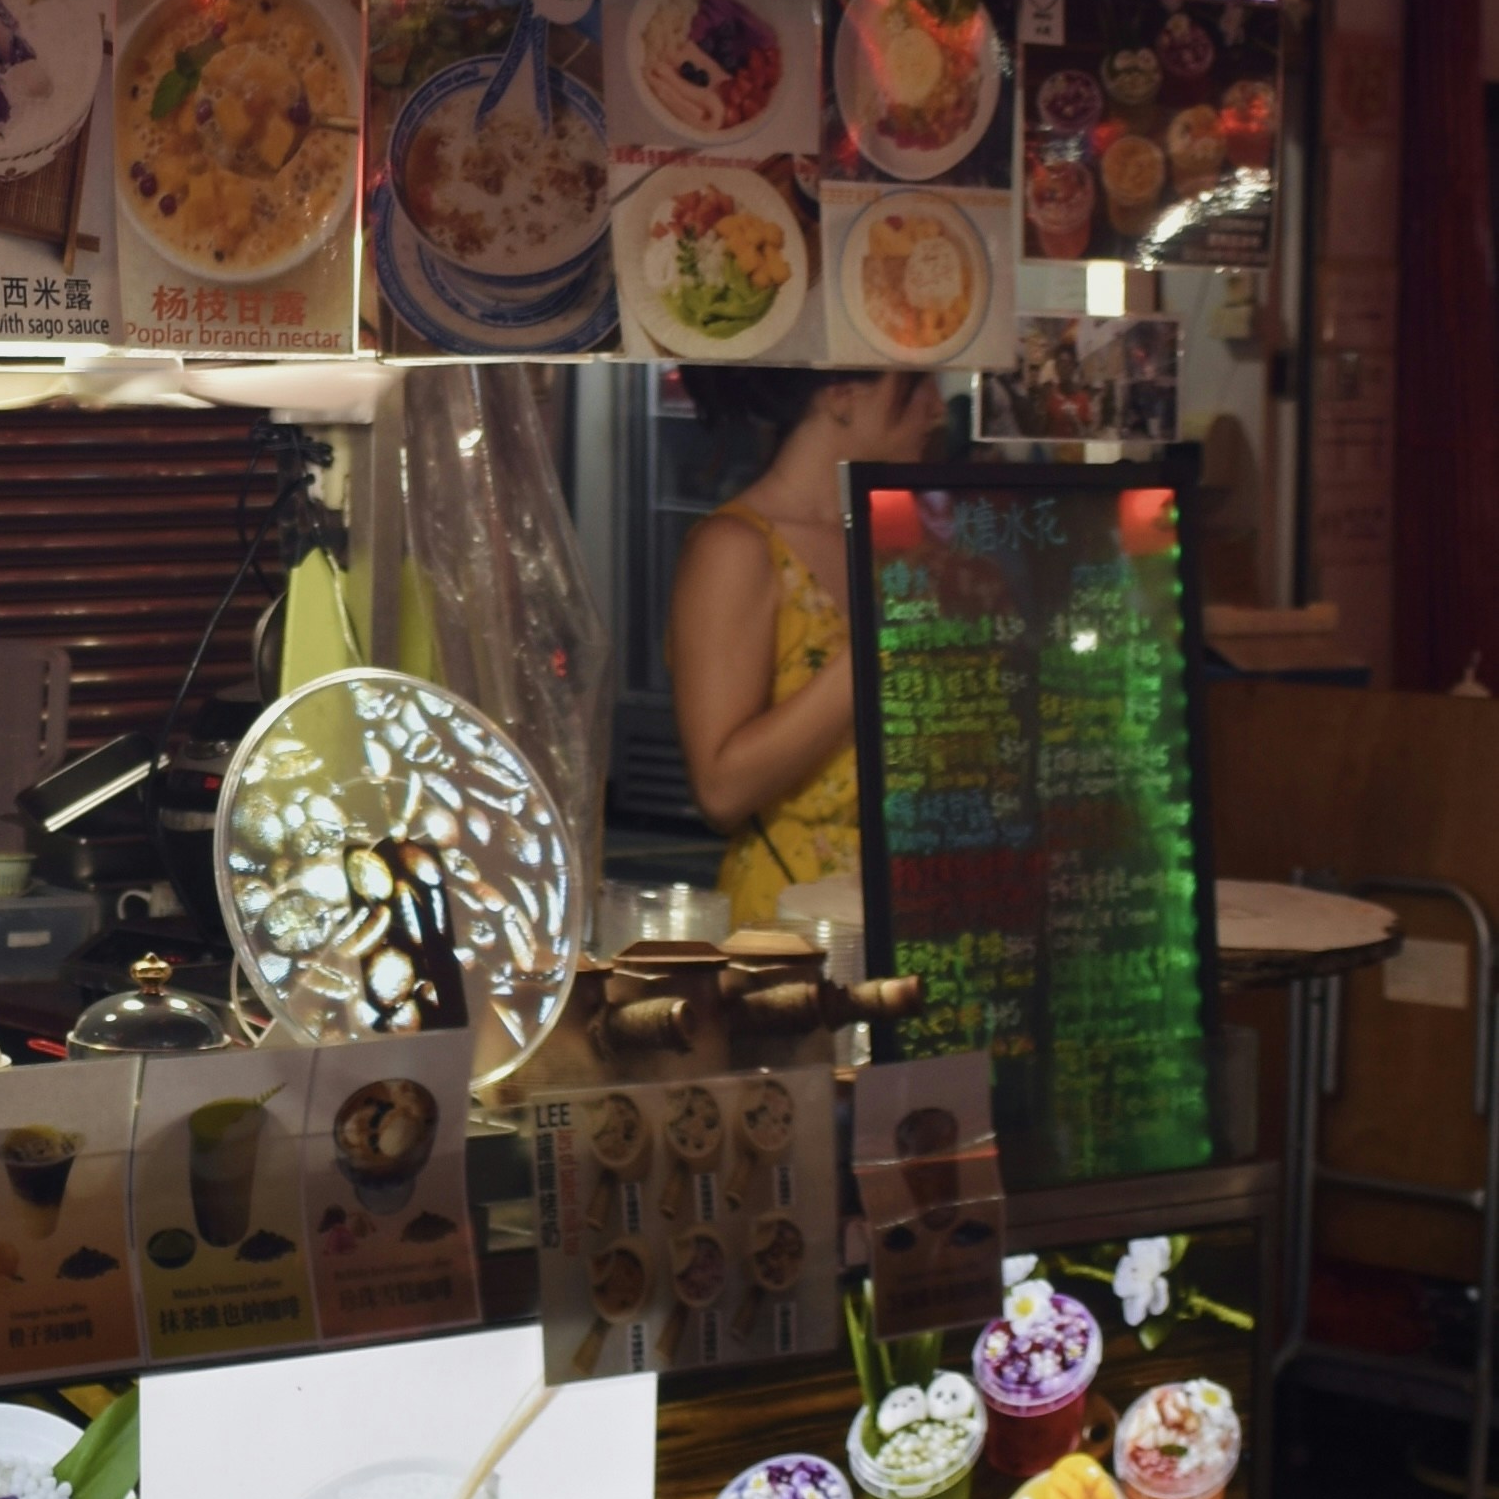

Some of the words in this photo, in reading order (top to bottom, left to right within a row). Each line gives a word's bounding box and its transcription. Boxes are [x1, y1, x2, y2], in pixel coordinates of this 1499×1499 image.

[153, 285, 308, 327] 杨枝甘露
[29, 317, 64, 340] sago
[67, 318, 110, 336] sauce
[125, 322, 196, 350] Poplar
[200, 323, 271, 349] branch
[277, 326, 342, 350] nectar
[535, 1103, 570, 1128] LEE
[249, 1277, 282, 1291] Coffee
